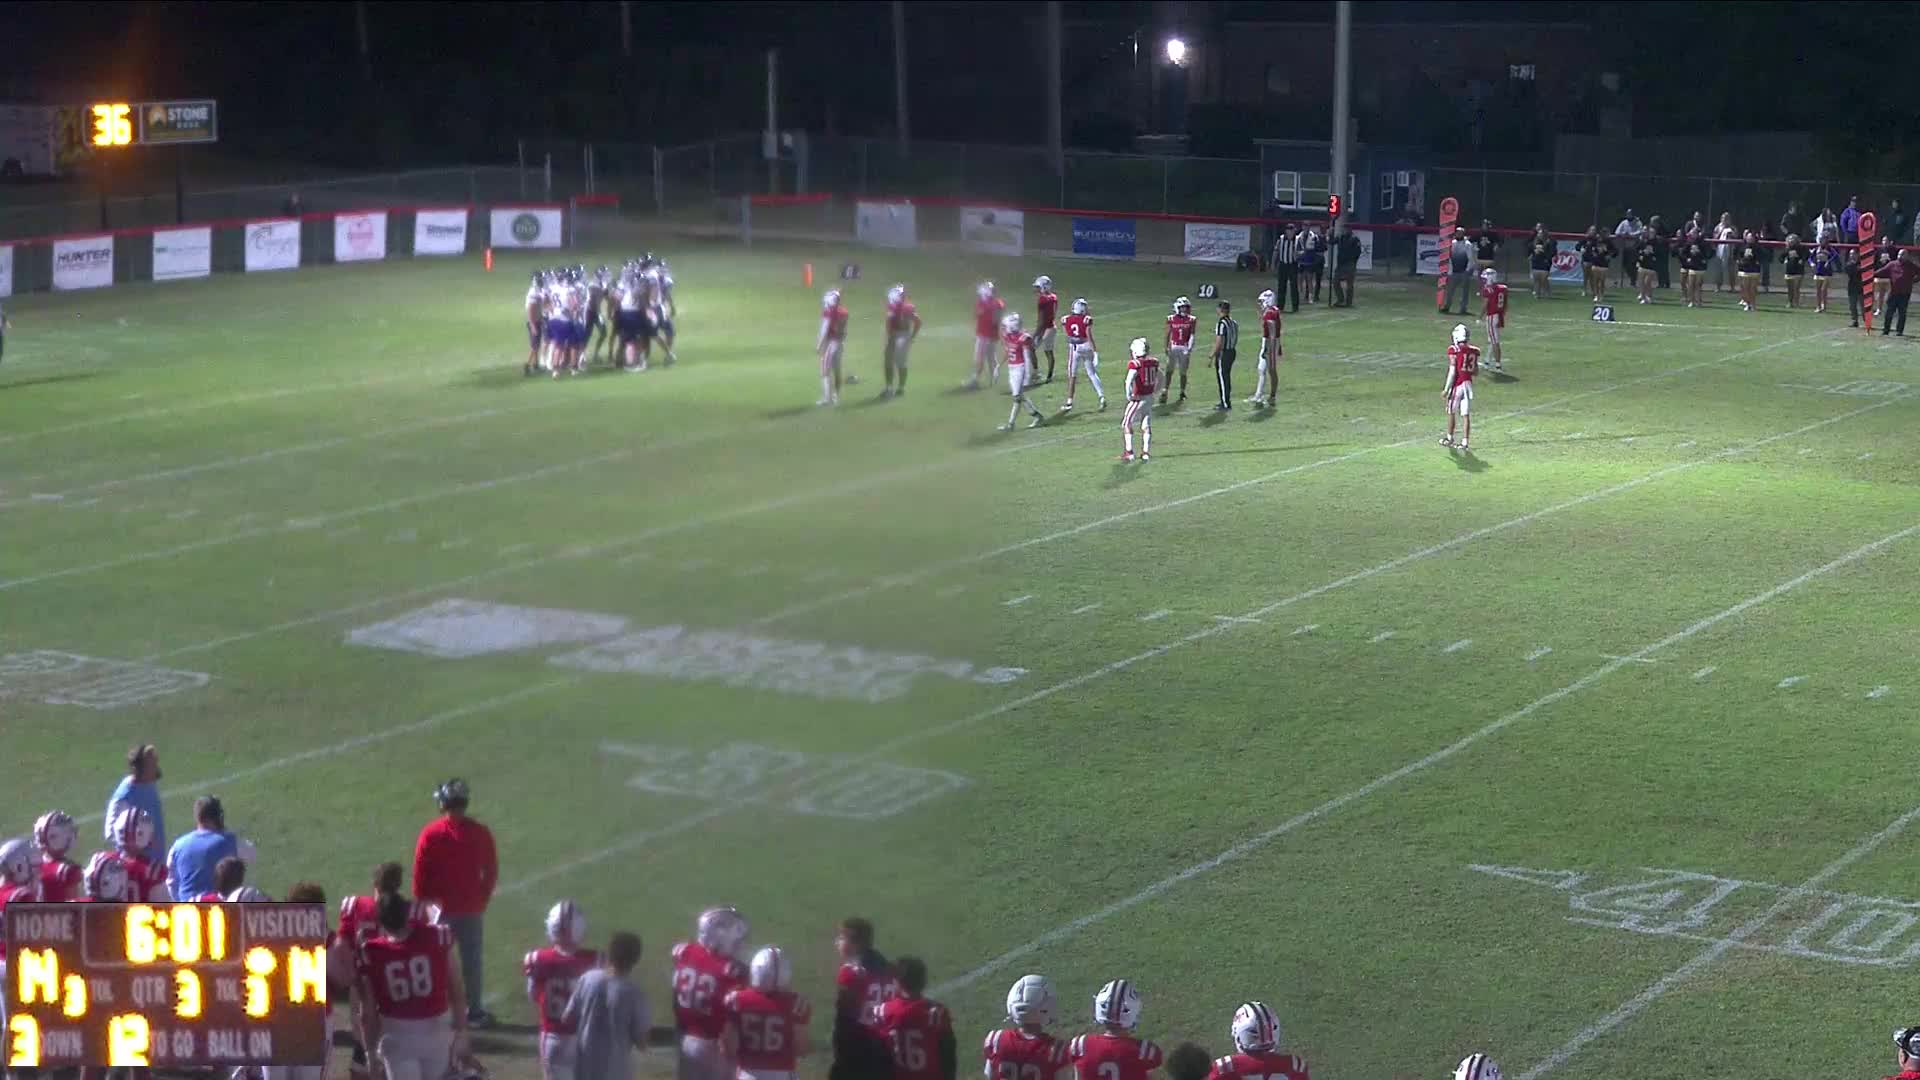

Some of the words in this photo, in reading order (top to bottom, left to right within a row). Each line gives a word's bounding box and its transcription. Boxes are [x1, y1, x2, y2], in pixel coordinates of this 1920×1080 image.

[167, 107, 208, 121] STONE
[92, 103, 132, 145] 36
[1329, 196, 1338, 213] 3
[57, 248, 111, 264] HUNTER
[1198, 284, 1215, 298] 10
[1593, 307, 1610, 321] 20
[1070, 323, 1079, 337] 3
[1461, 353, 1476, 372] 13
[385, 955, 433, 1002] 68
[740, 1013, 785, 1052] 56
